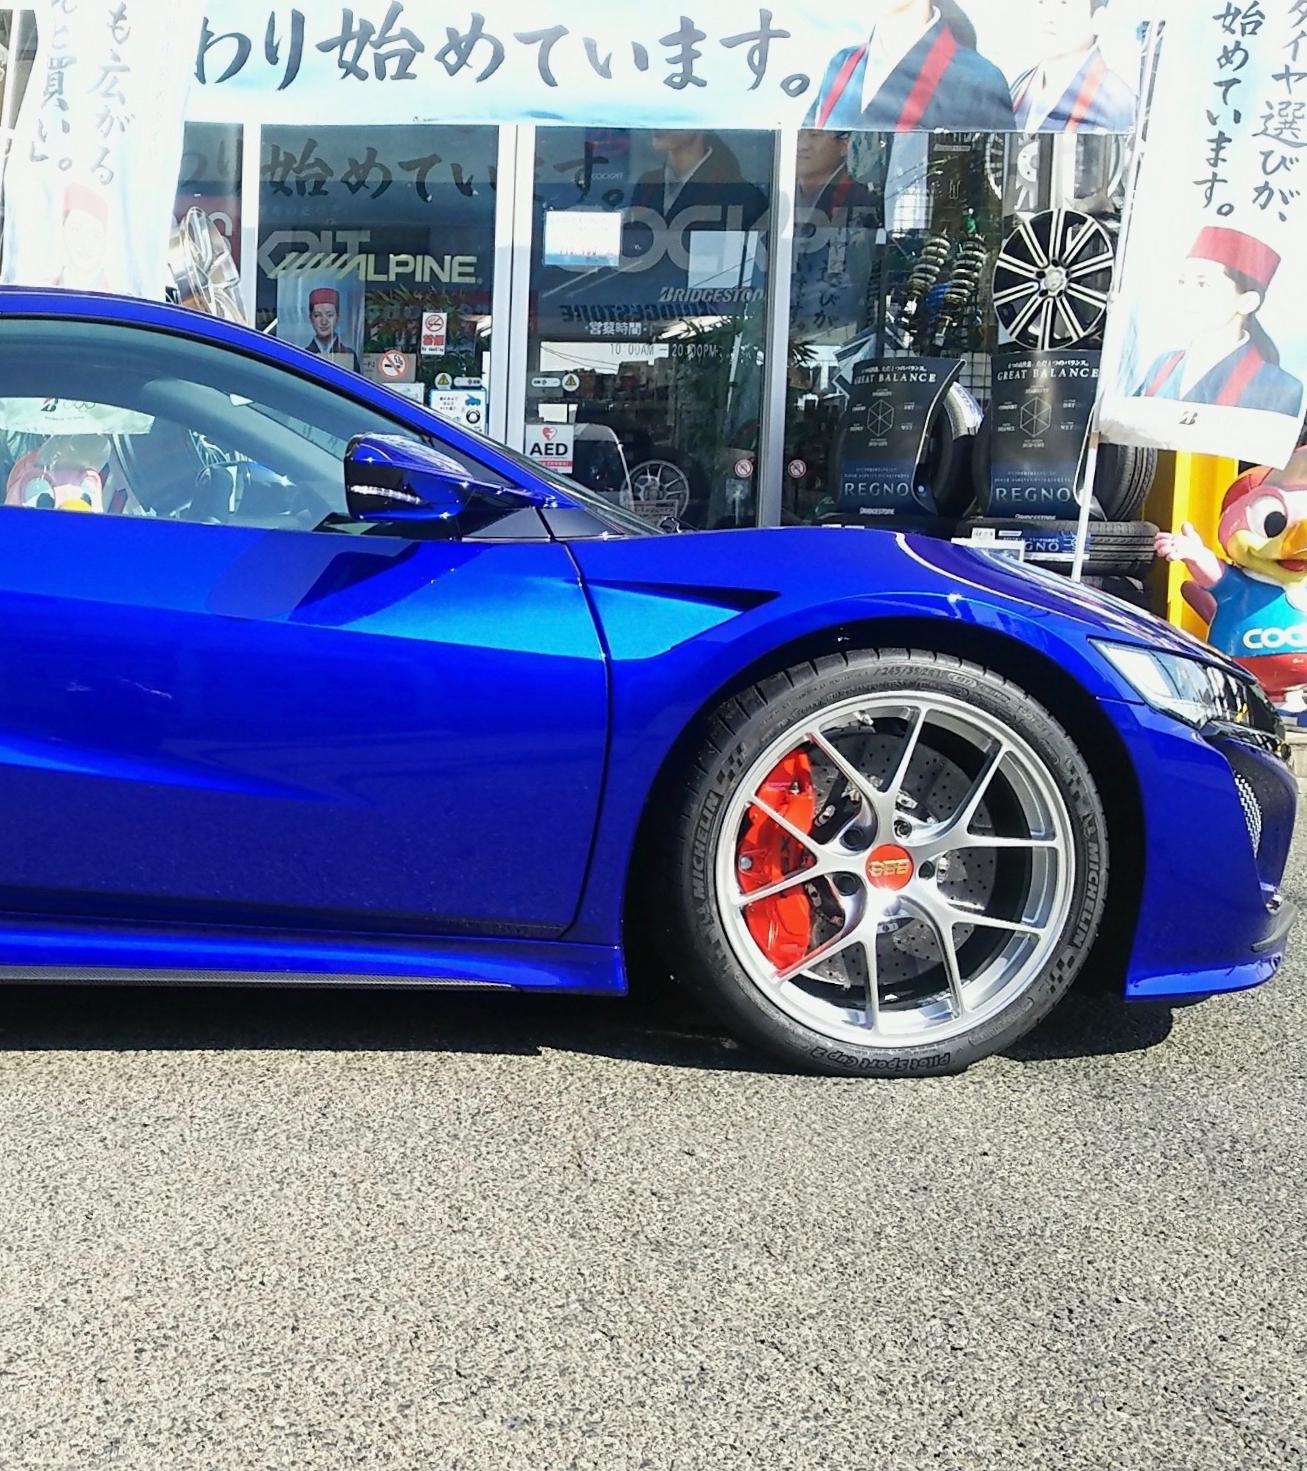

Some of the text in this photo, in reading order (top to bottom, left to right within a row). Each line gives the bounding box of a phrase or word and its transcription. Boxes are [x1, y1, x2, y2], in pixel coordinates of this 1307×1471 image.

[194, 0, 810, 98] わり始めています。
[1193, 0, 1265, 216] 始めています。
[298, 252, 478, 284] ALPINE
[878, 373, 937, 383] BALANCE
[997, 368, 1100, 381] GREAT BALANCE
[530, 442, 568, 456] AED
[844, 482, 909, 497] REGNO
[995, 487, 1071, 502] REGNO
[1025, 541, 1060, 553] GNO
[692, 790, 724, 901] MICHELIN
[1072, 842, 1099, 949] MICHELIN
[809, 1046, 951, 1073] Pilot Sport Cup 2
